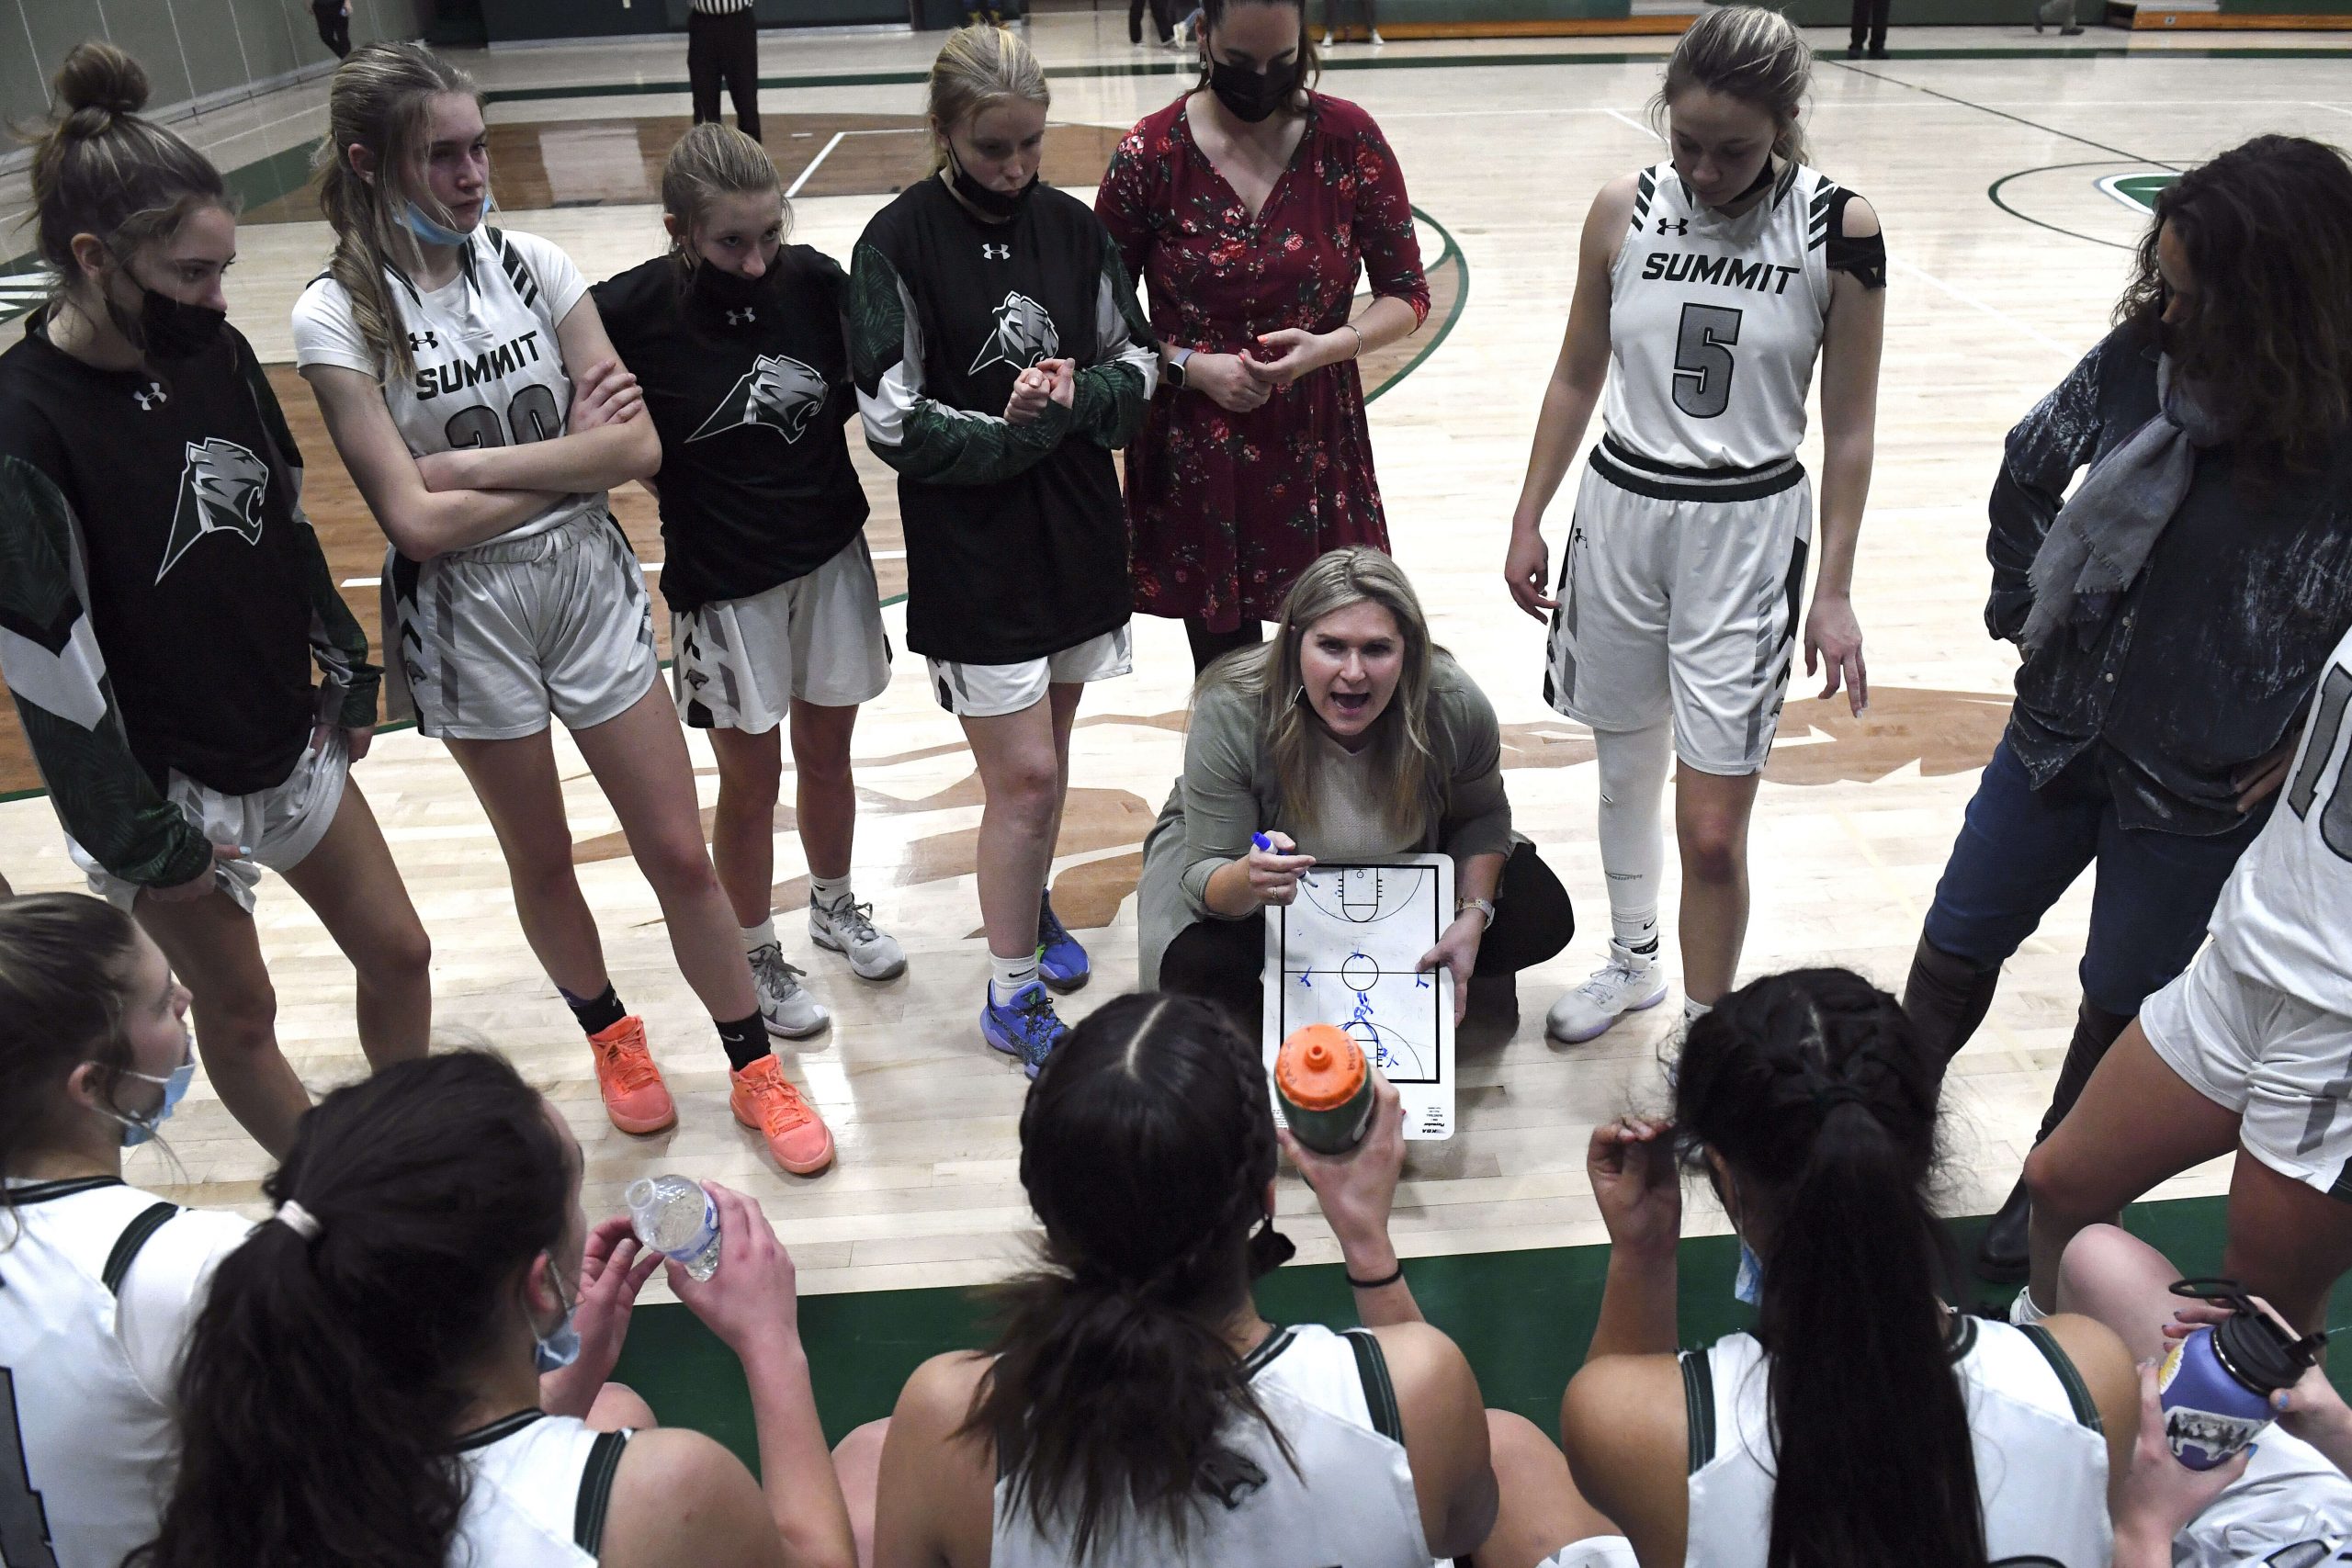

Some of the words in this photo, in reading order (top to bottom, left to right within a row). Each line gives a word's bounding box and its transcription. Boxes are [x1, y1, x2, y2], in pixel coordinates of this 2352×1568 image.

[1642, 253, 1800, 295] SUMMIT
[415, 330, 539, 401] SUMMIT
[1671, 301, 1743, 419] 5
